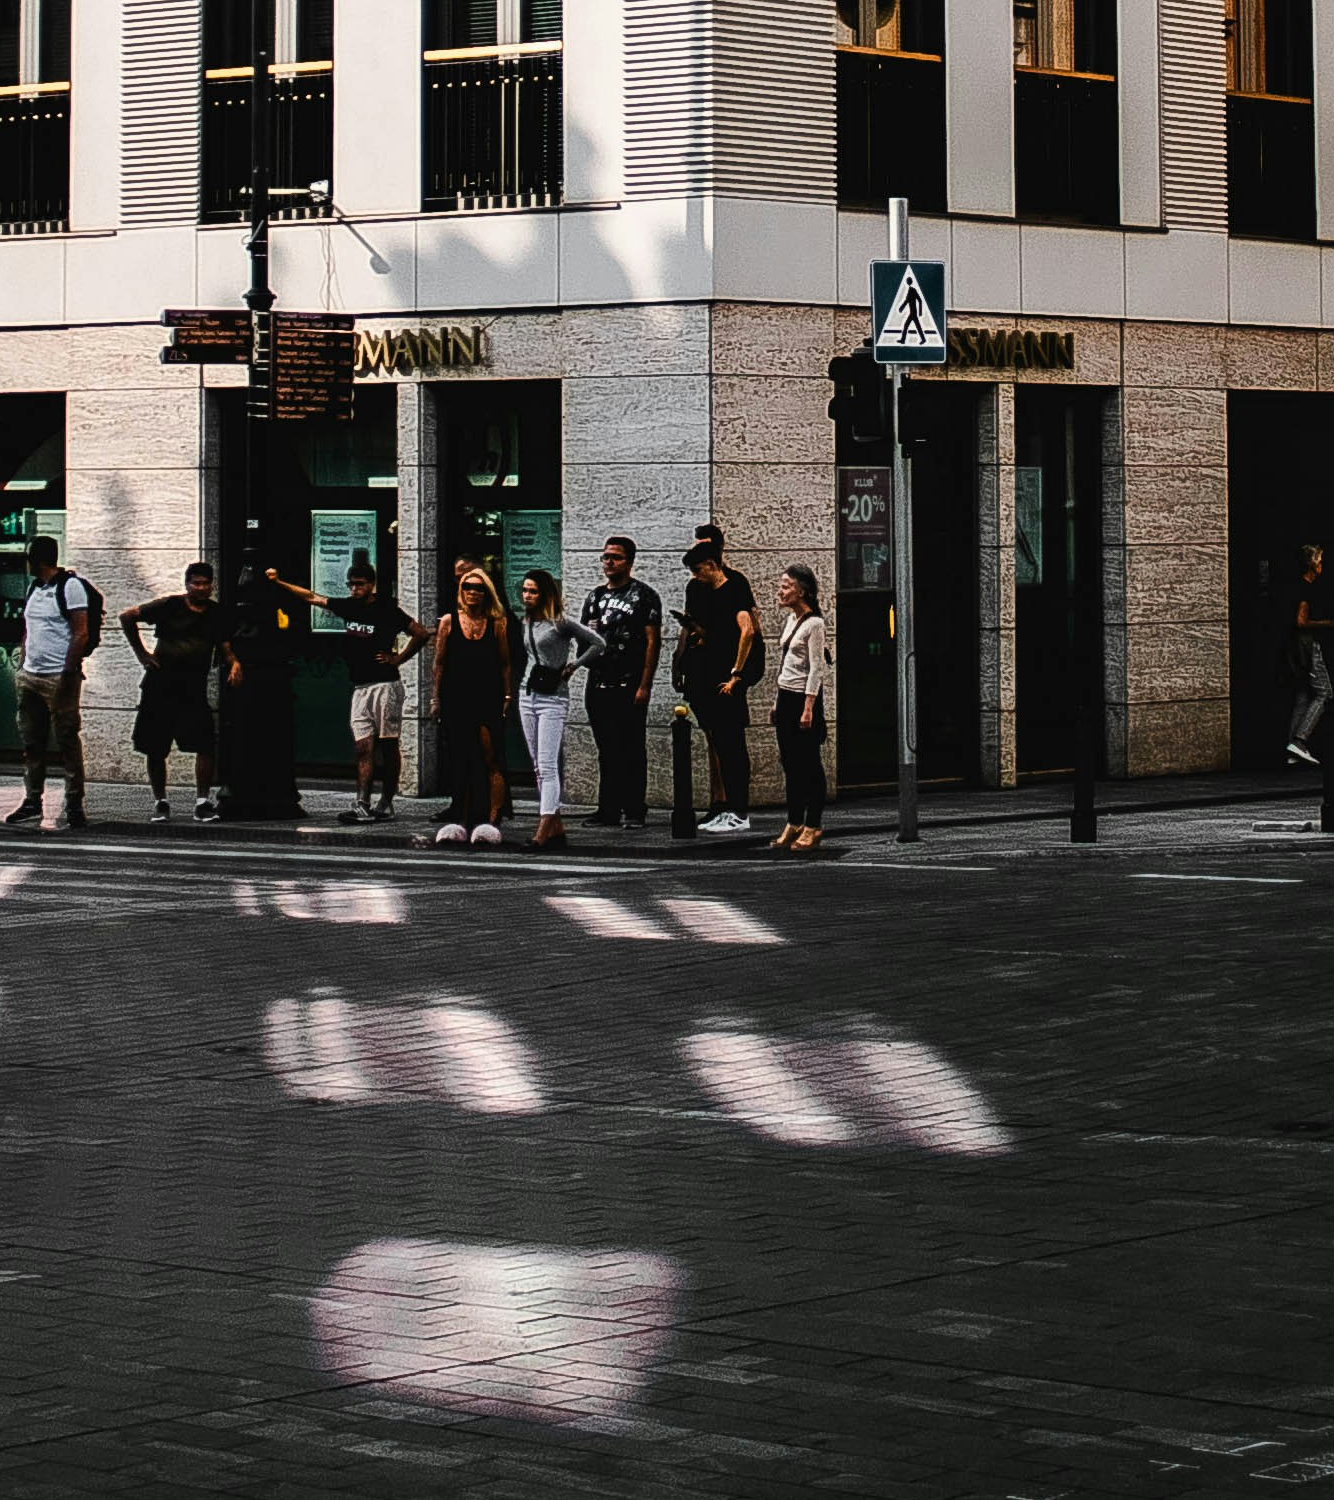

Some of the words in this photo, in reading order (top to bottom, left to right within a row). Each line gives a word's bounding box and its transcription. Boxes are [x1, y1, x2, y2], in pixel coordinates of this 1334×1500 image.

[353, 326, 481, 375] MANN
[947, 327, 1074, 369] SSMANN
[842, 495, 885, 522] -20%
